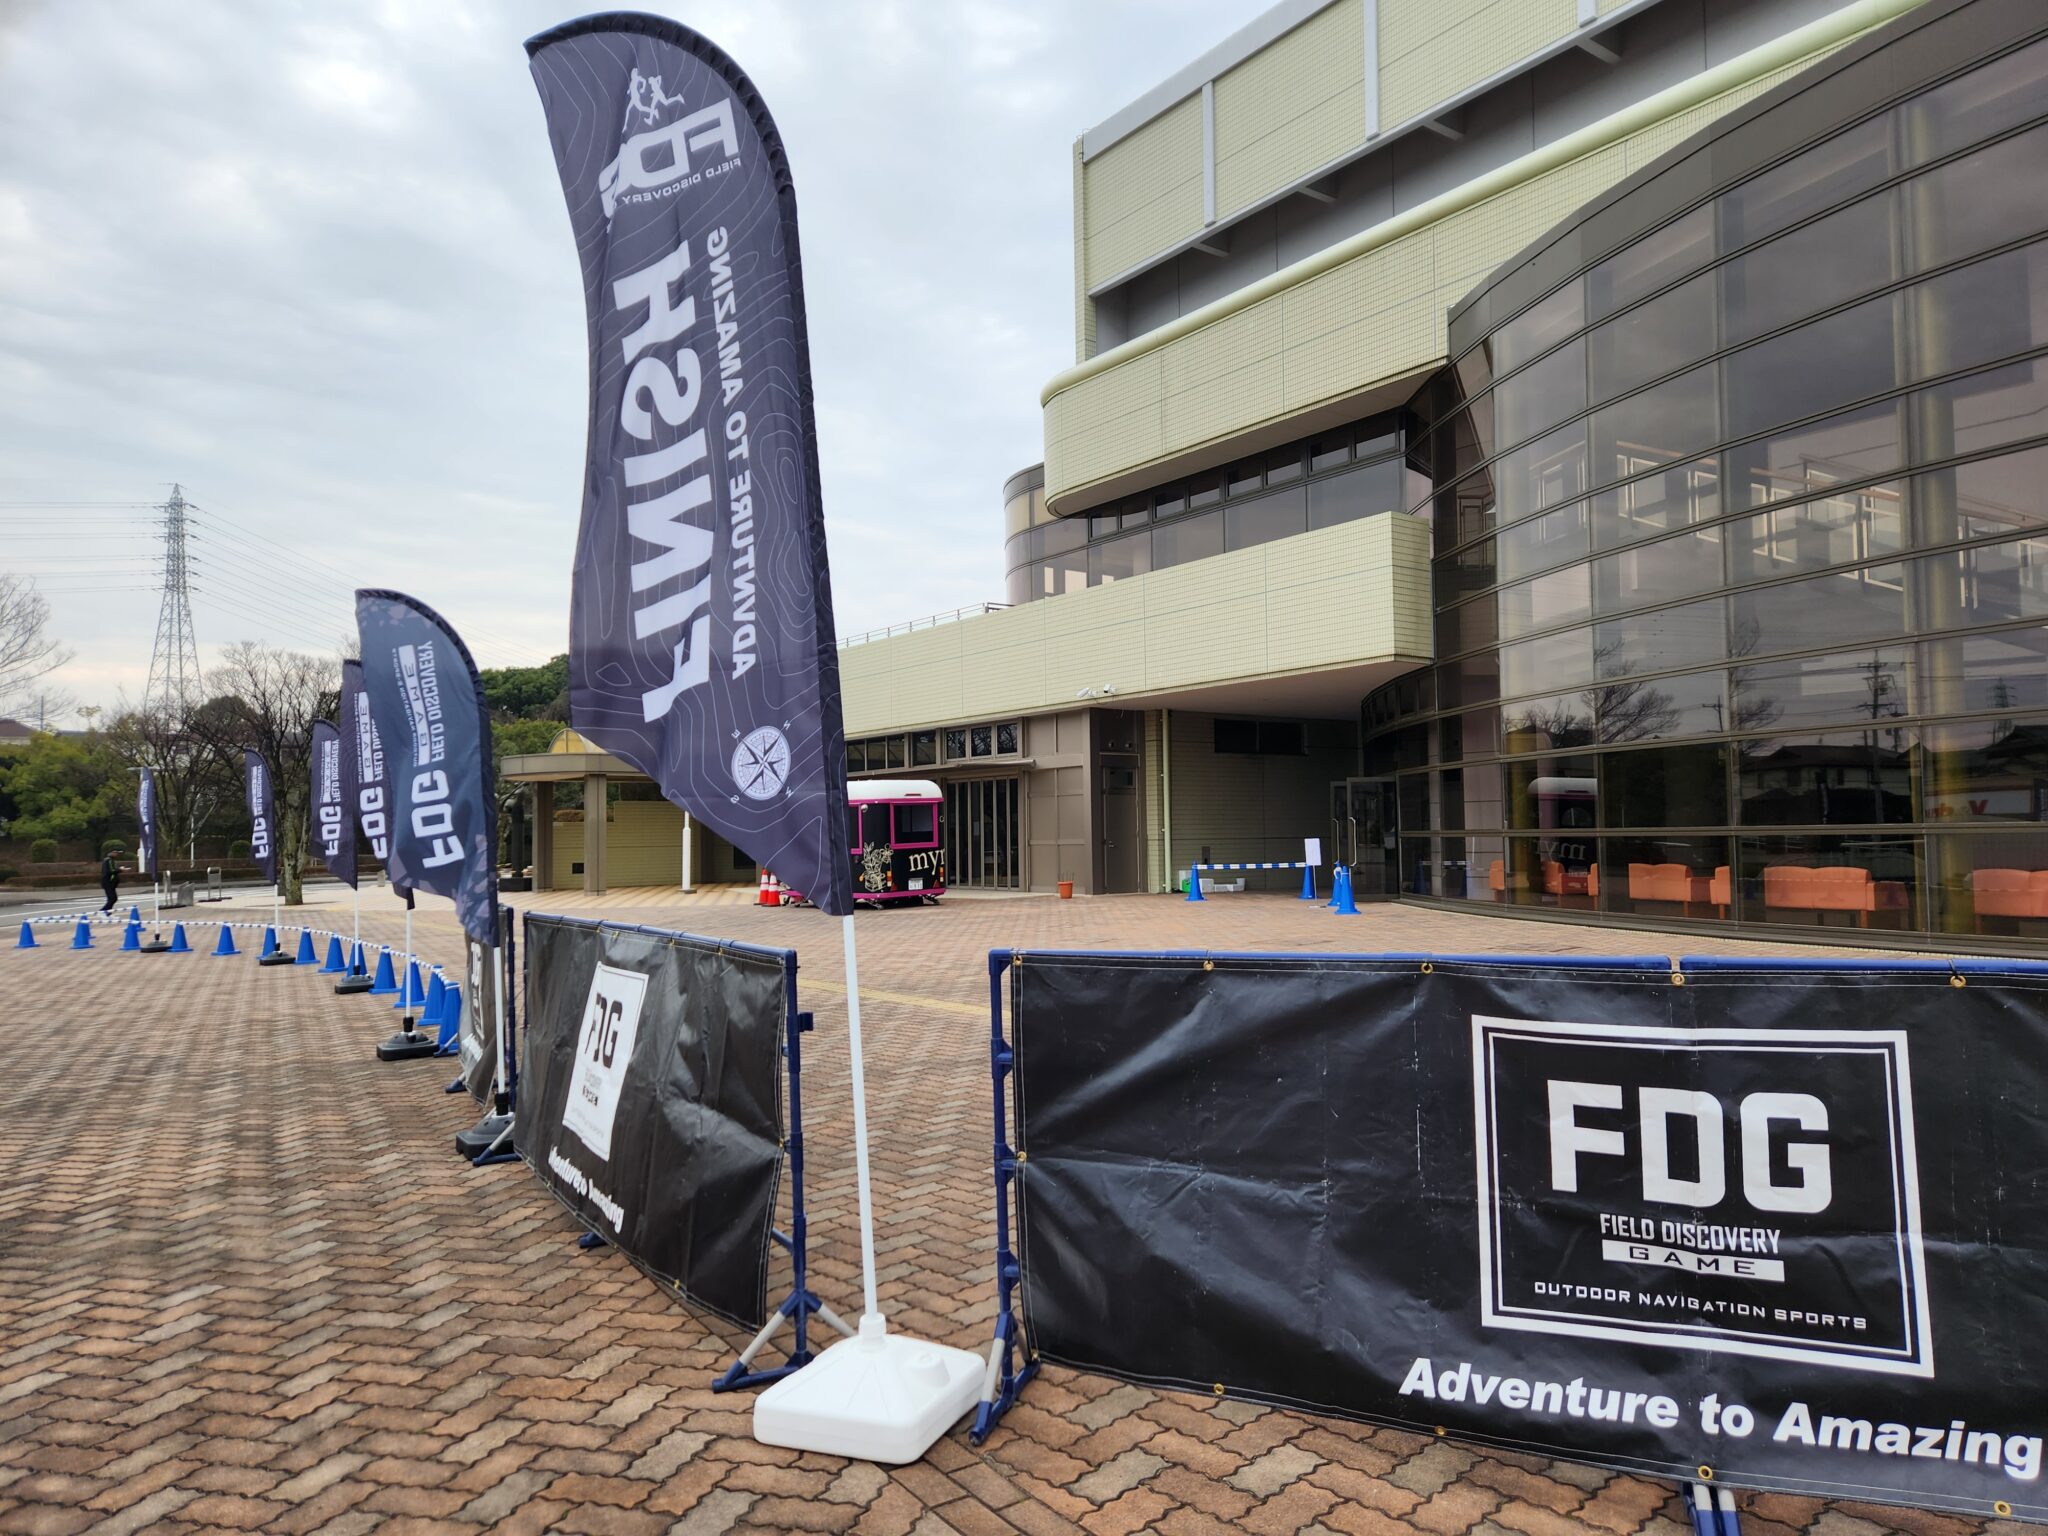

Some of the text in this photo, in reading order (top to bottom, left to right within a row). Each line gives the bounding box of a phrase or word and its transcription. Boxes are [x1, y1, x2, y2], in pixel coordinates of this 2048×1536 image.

[1547, 1080, 1832, 1214] FDG
[1600, 1213, 1780, 1254] FIELD DISCOVERY
[1629, 1246, 1755, 1275] GAME
[1535, 1281, 1867, 1329] OUTDOOR NAVIGATION SPORTS
[1399, 1357, 2043, 1480] Adventure to Amazing
